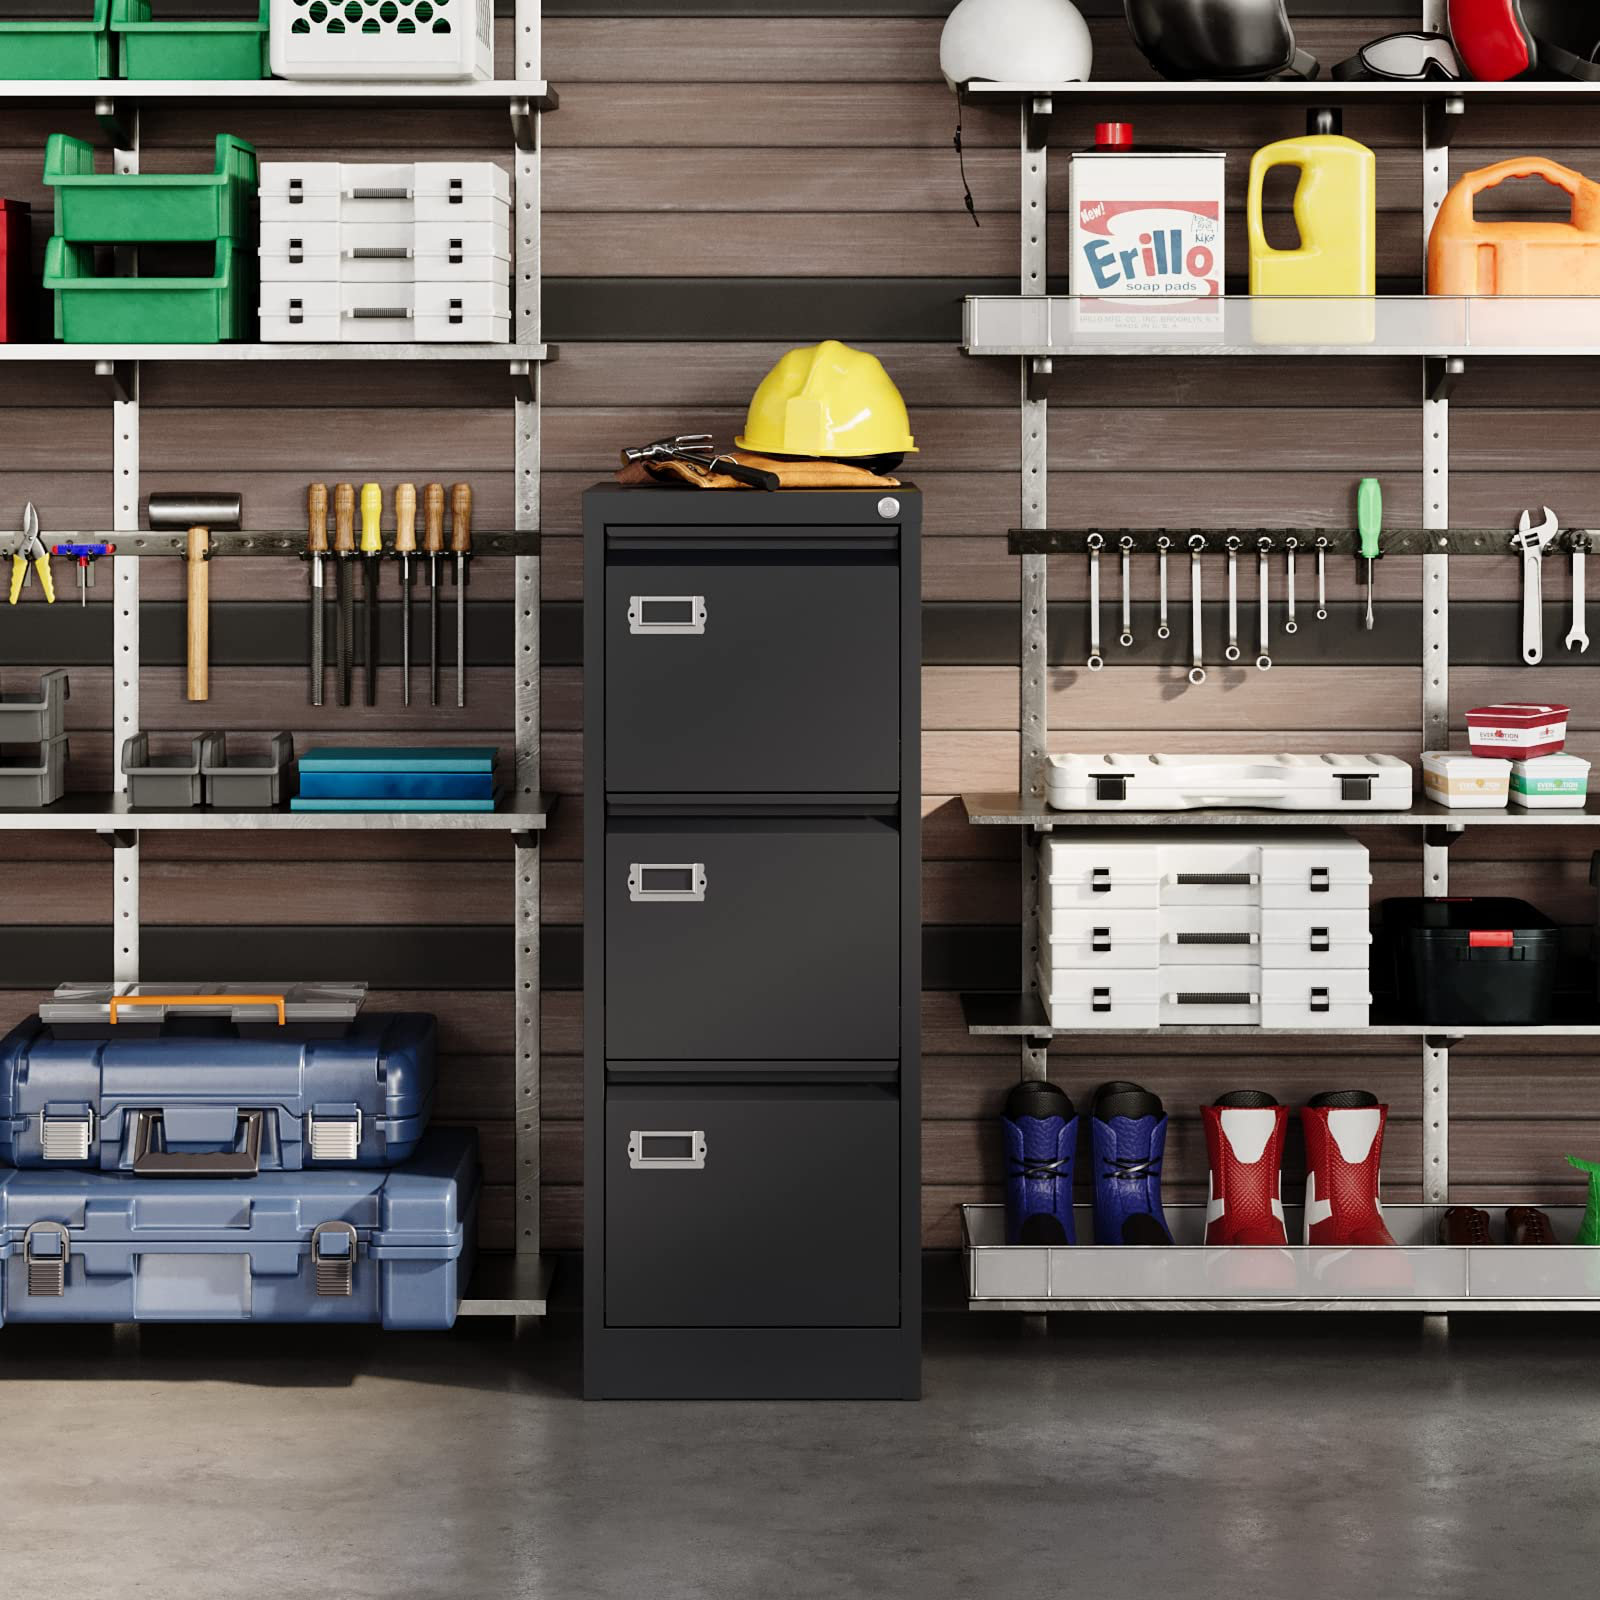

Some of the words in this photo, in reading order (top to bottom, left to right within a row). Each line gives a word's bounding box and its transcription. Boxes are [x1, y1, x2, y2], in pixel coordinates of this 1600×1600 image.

[1080, 202, 1105, 224] New!
[1083, 229, 1213, 289] Erillo
[1126, 282, 1160, 292] soap
[1165, 281, 1197, 292] pads
